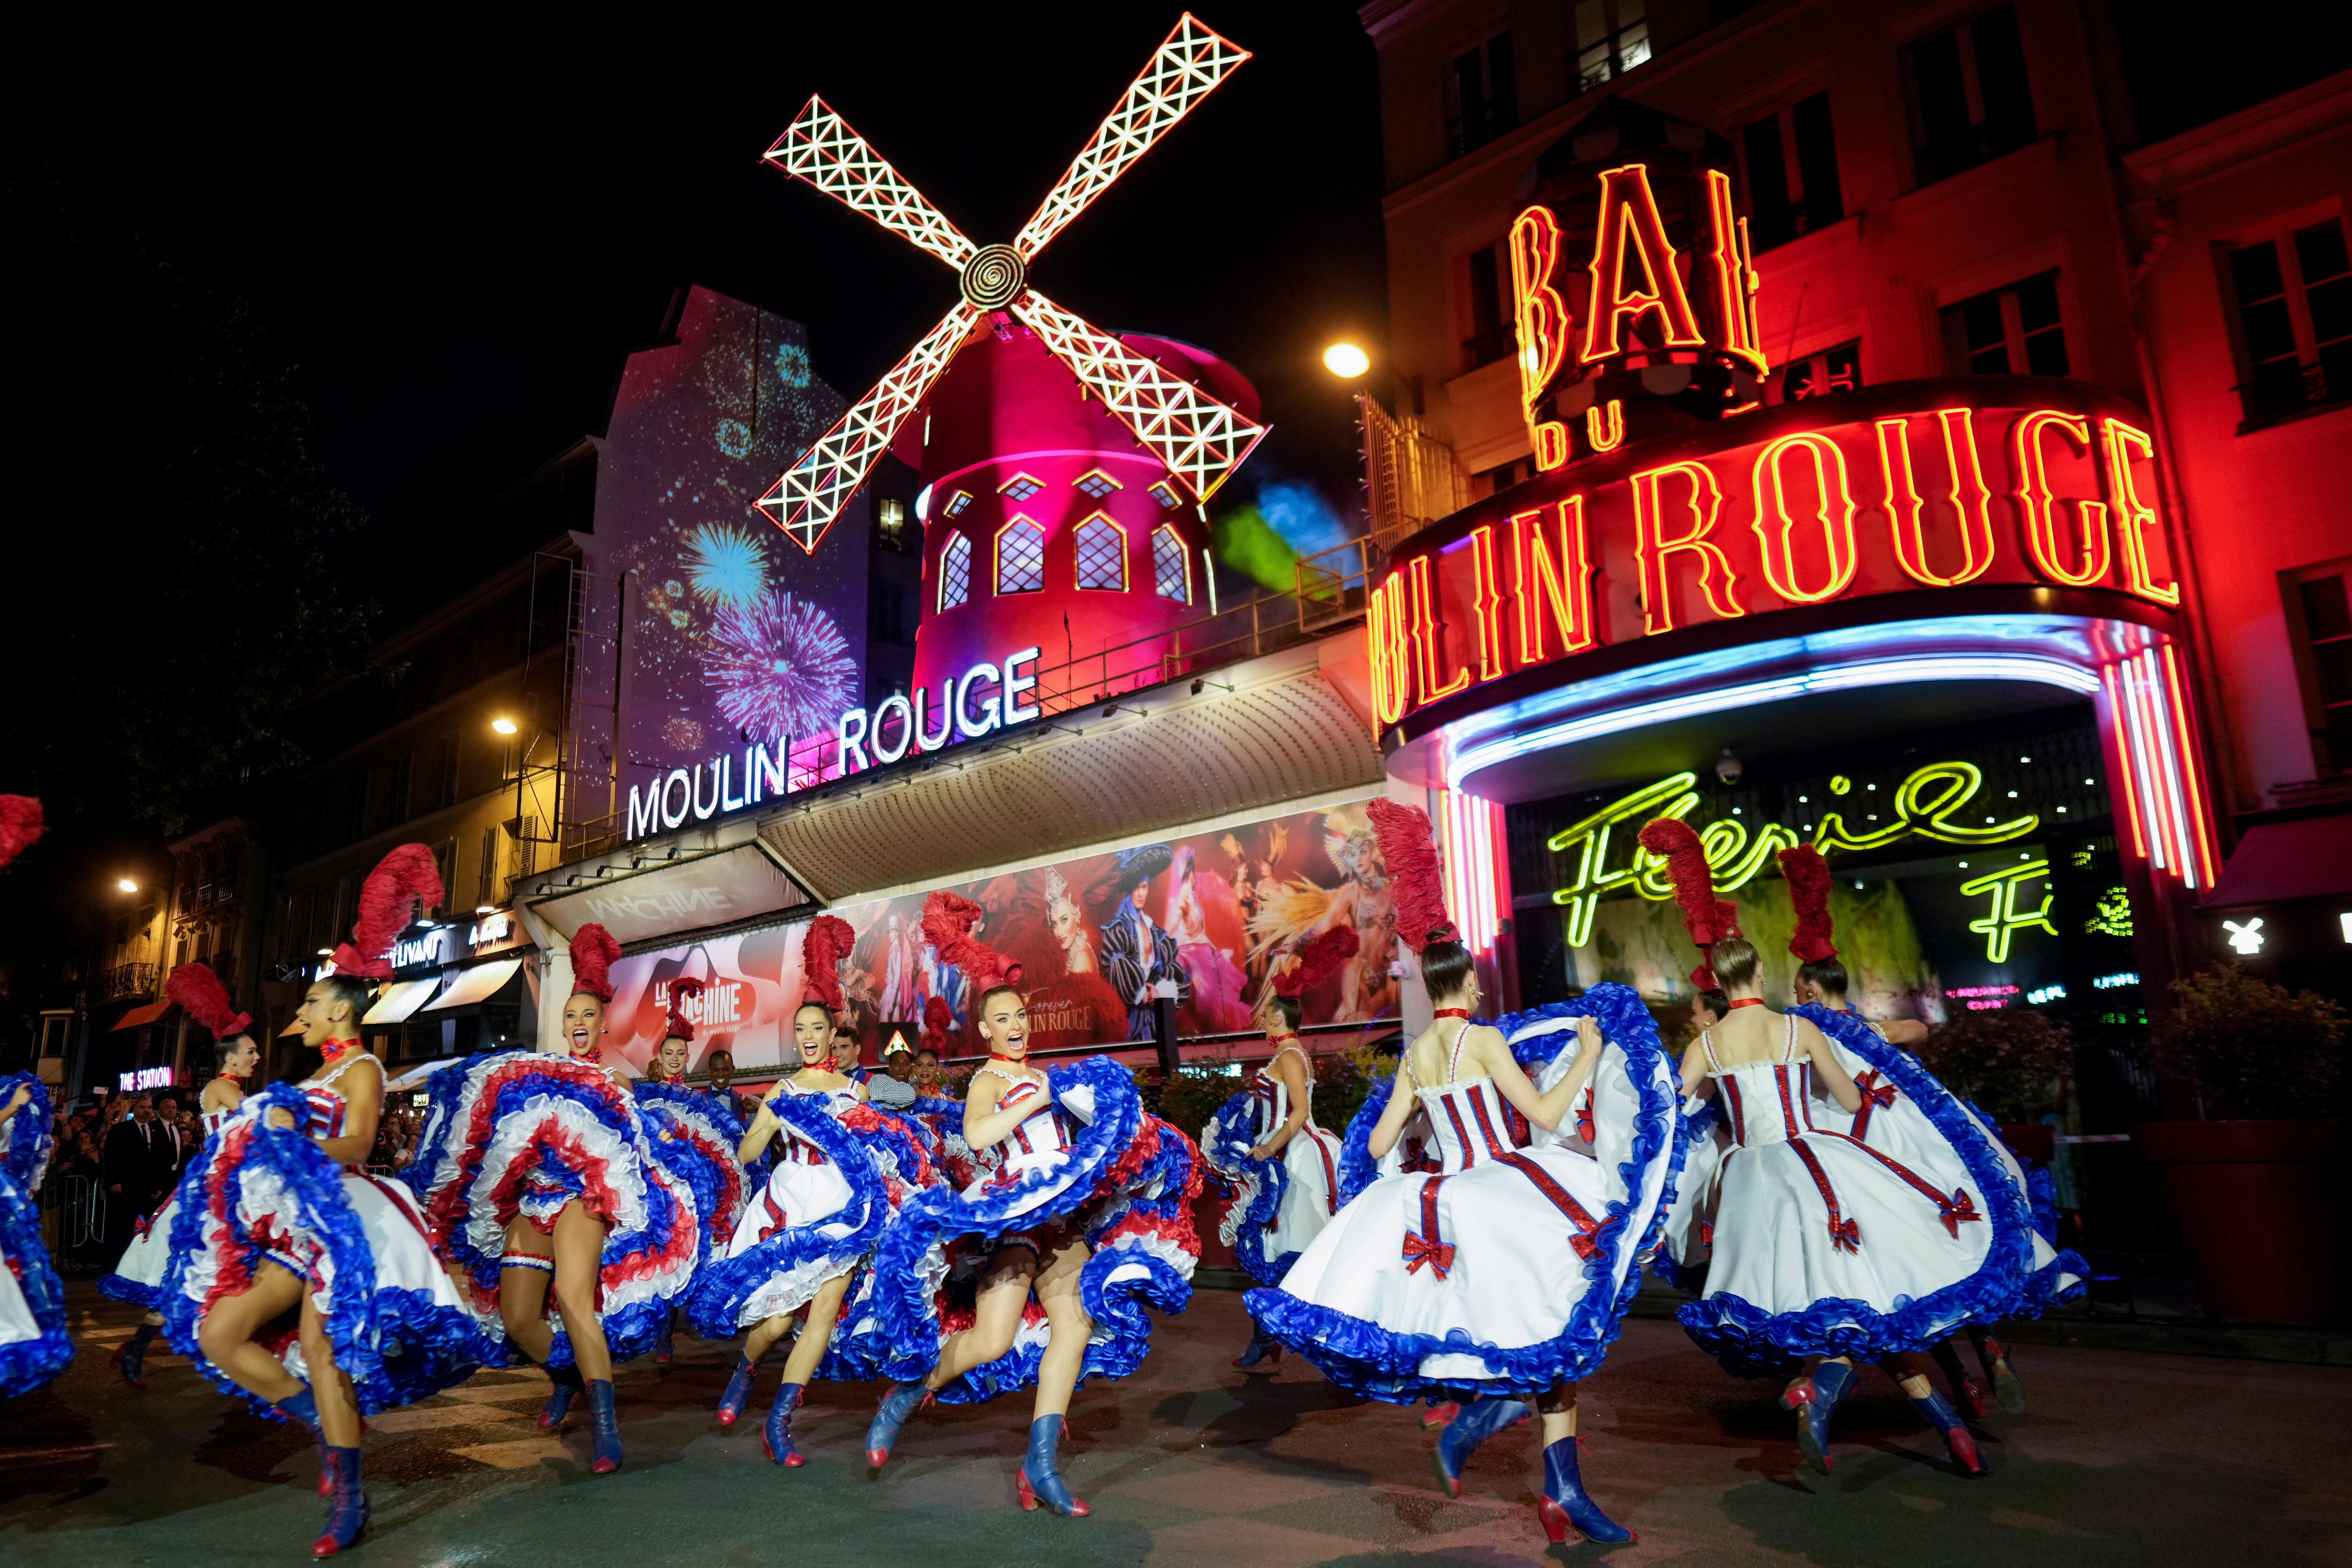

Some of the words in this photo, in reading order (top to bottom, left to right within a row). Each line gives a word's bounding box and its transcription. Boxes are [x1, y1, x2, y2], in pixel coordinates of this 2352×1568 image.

[1510, 163, 1770, 422] BAL
[1535, 399, 1626, 472] DU
[1366, 494, 1594, 743] ULIN
[1629, 407, 2180, 636] ROUGE
[626, 734, 790, 841] MOULIN
[839, 646, 1041, 776] ROUGE
[656, 982, 667, 1001] LA
[1027, 1014, 1046, 1034] LIN
[1049, 1006, 1091, 1031] ROUGE
[120, 1072, 135, 1091] THE
[137, 1066, 170, 1091] STATION
